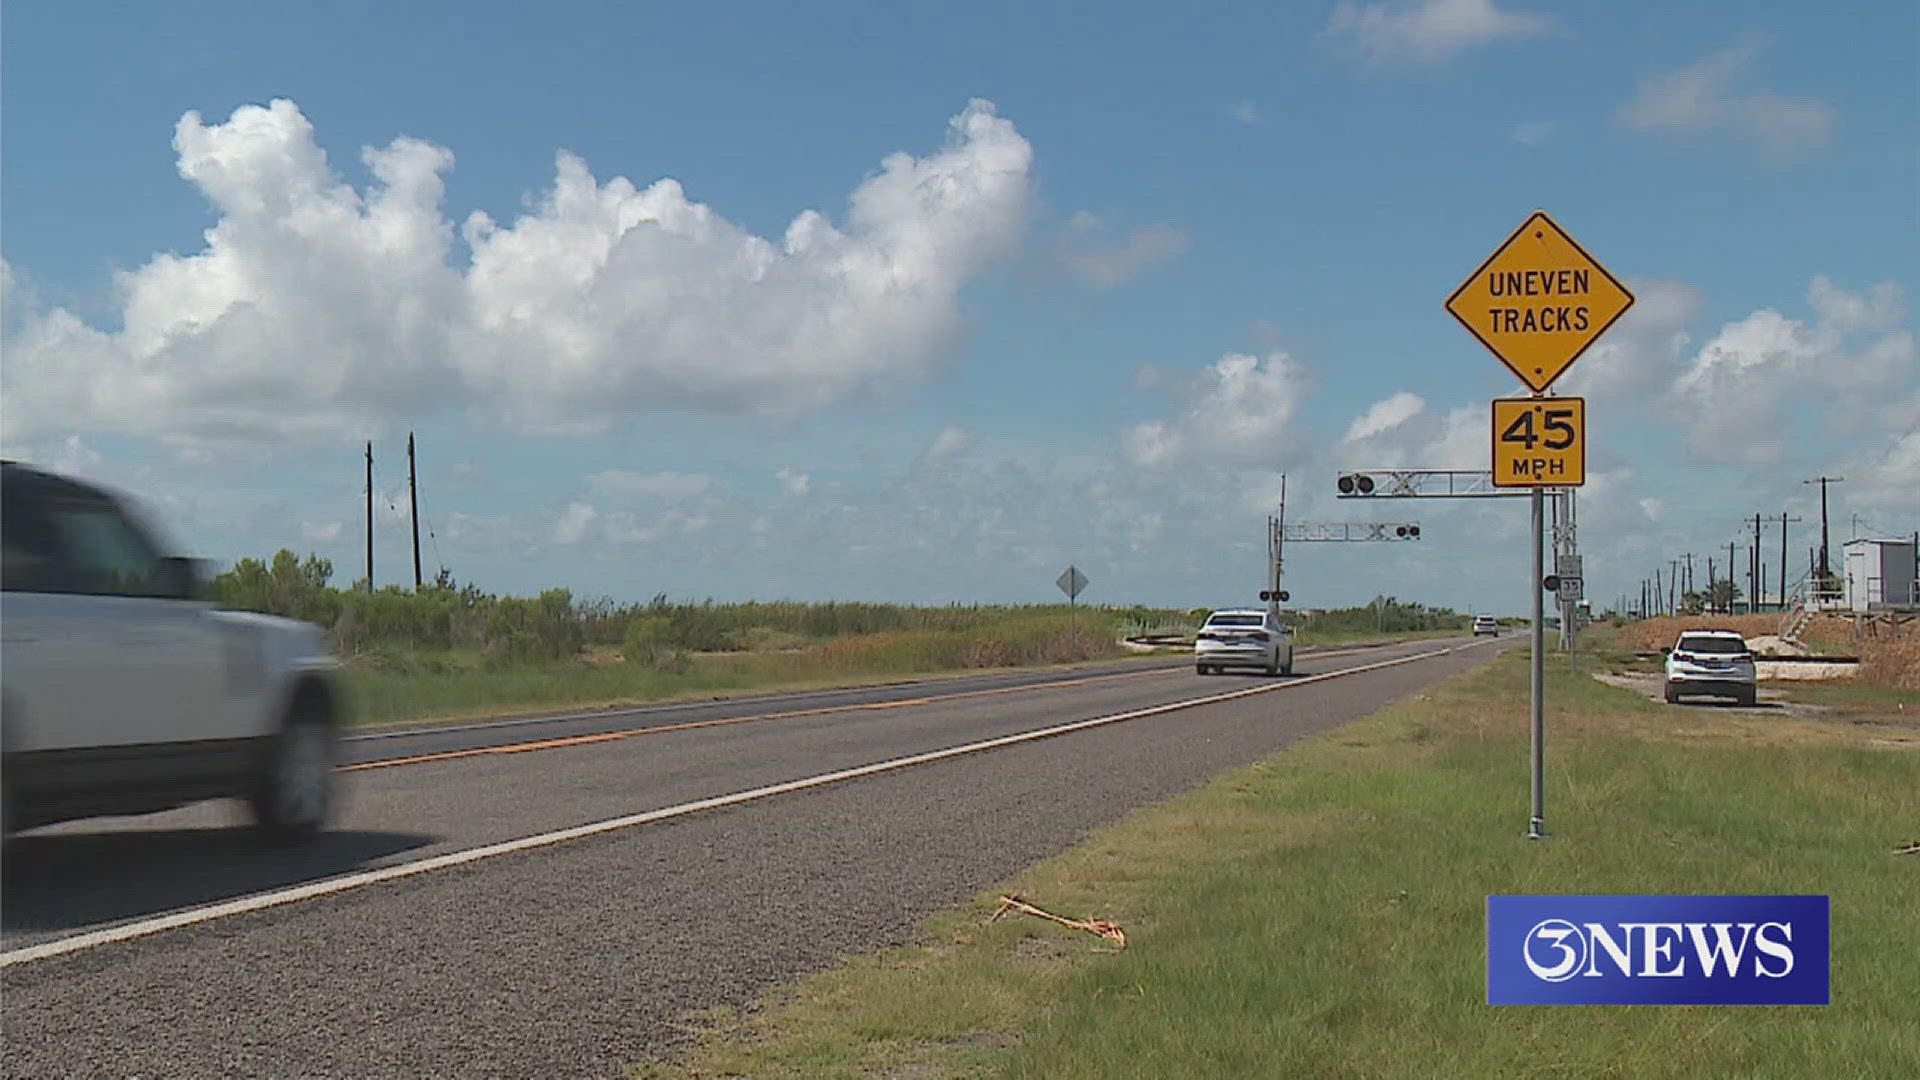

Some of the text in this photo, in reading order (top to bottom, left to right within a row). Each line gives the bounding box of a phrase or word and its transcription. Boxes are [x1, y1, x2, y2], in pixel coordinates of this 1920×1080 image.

[1489, 270, 1589, 296] UNEVEN
[1489, 307, 1589, 333] TRACKS
[1501, 410, 1575, 450] 45
[1512, 458, 1565, 476] MPH
